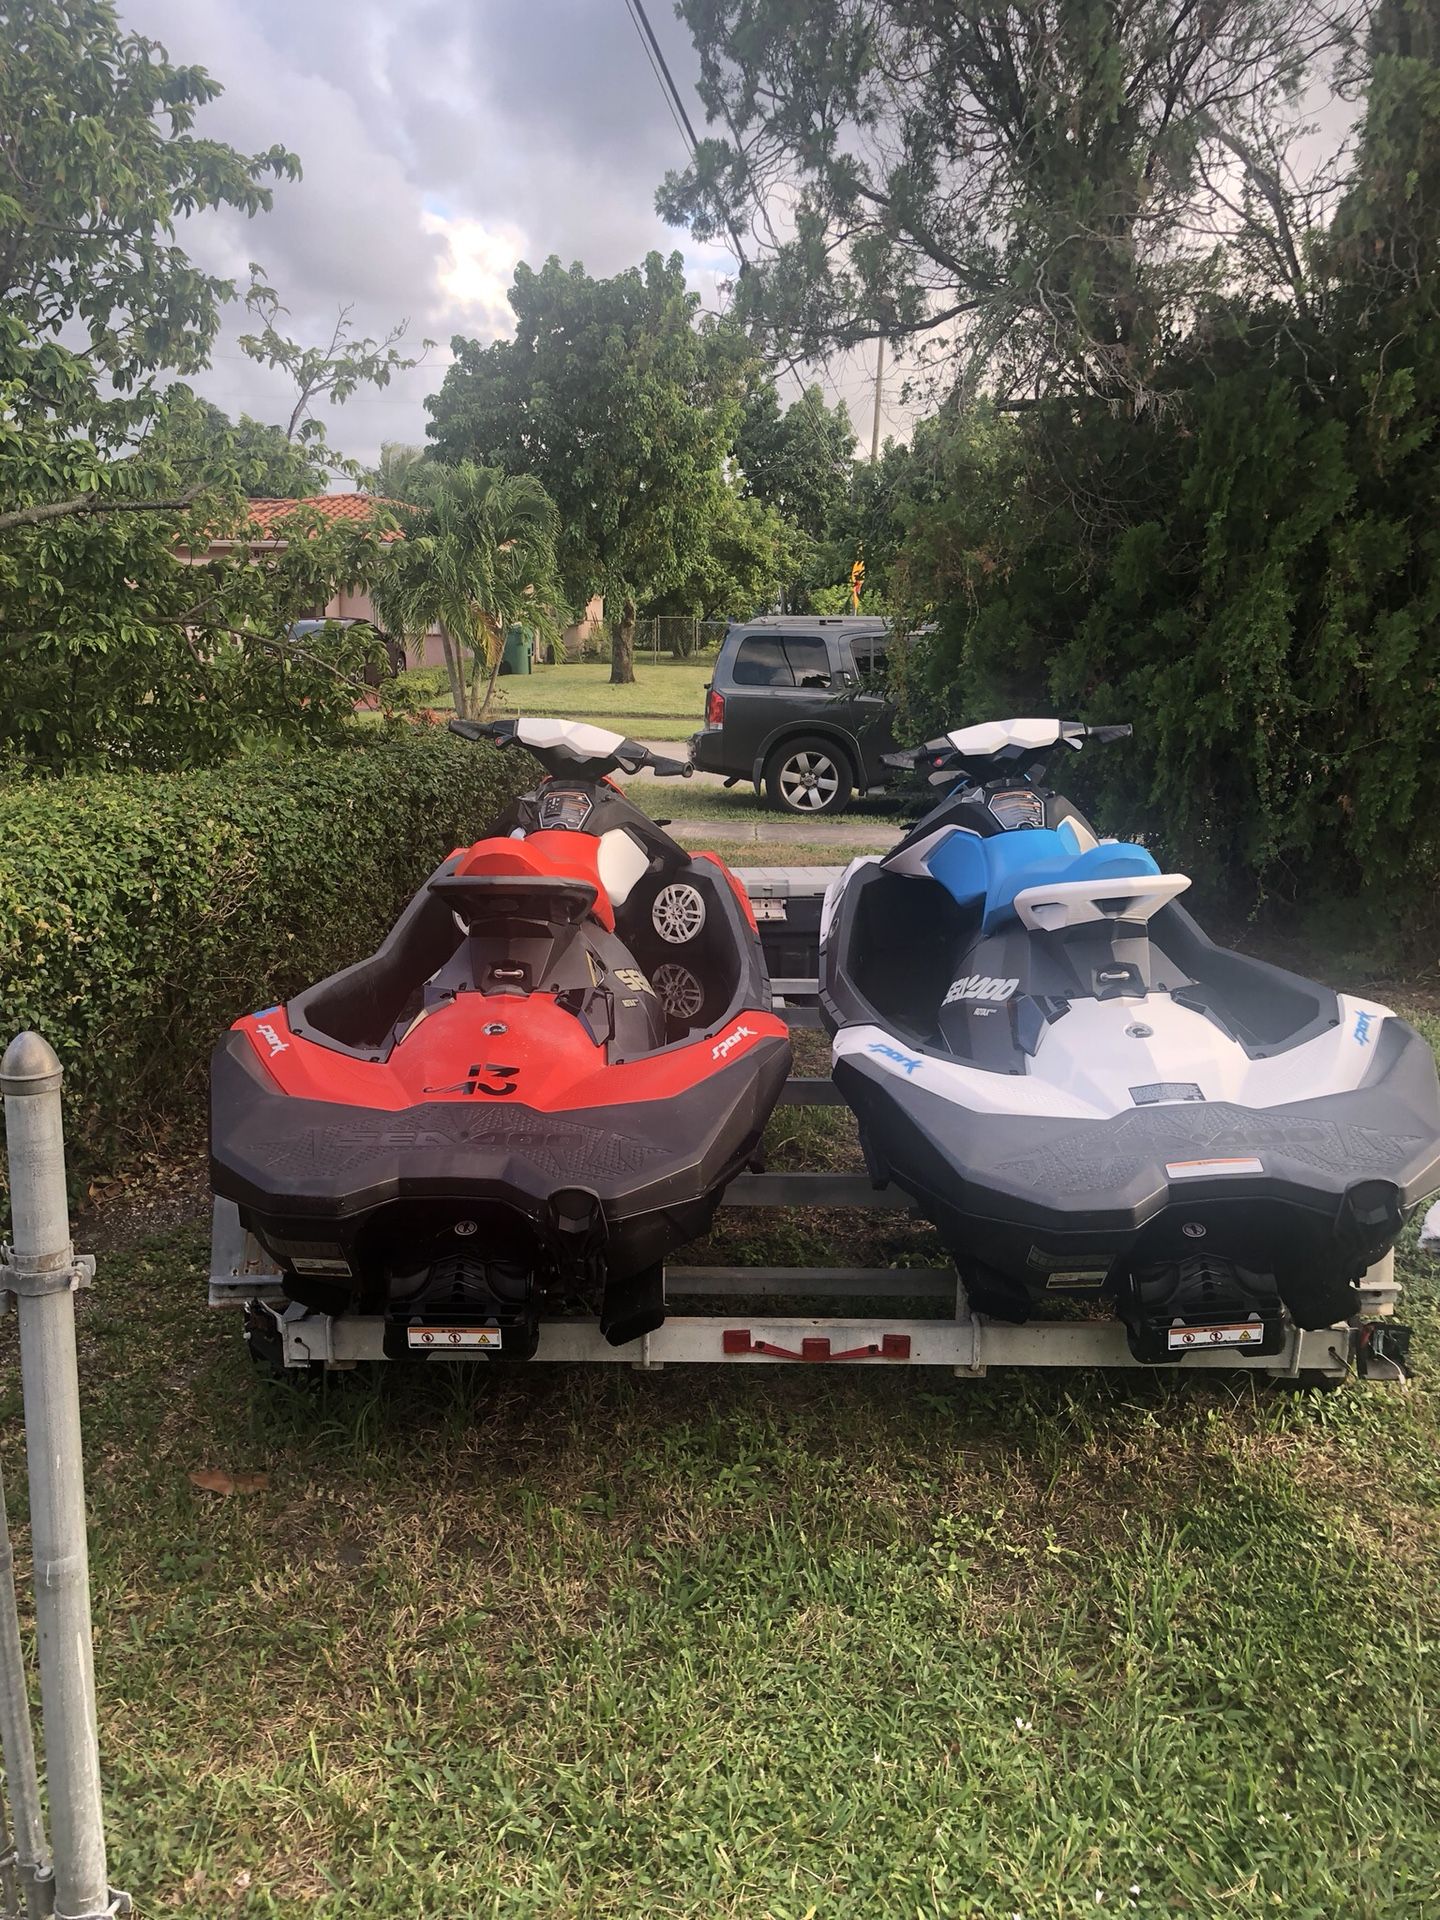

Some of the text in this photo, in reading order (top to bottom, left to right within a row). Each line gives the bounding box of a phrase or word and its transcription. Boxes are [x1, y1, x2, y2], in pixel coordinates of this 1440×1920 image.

[256, 1024, 290, 1057] spark
[711, 1026, 758, 1060] spark
[868, 1043, 922, 1074] spark
